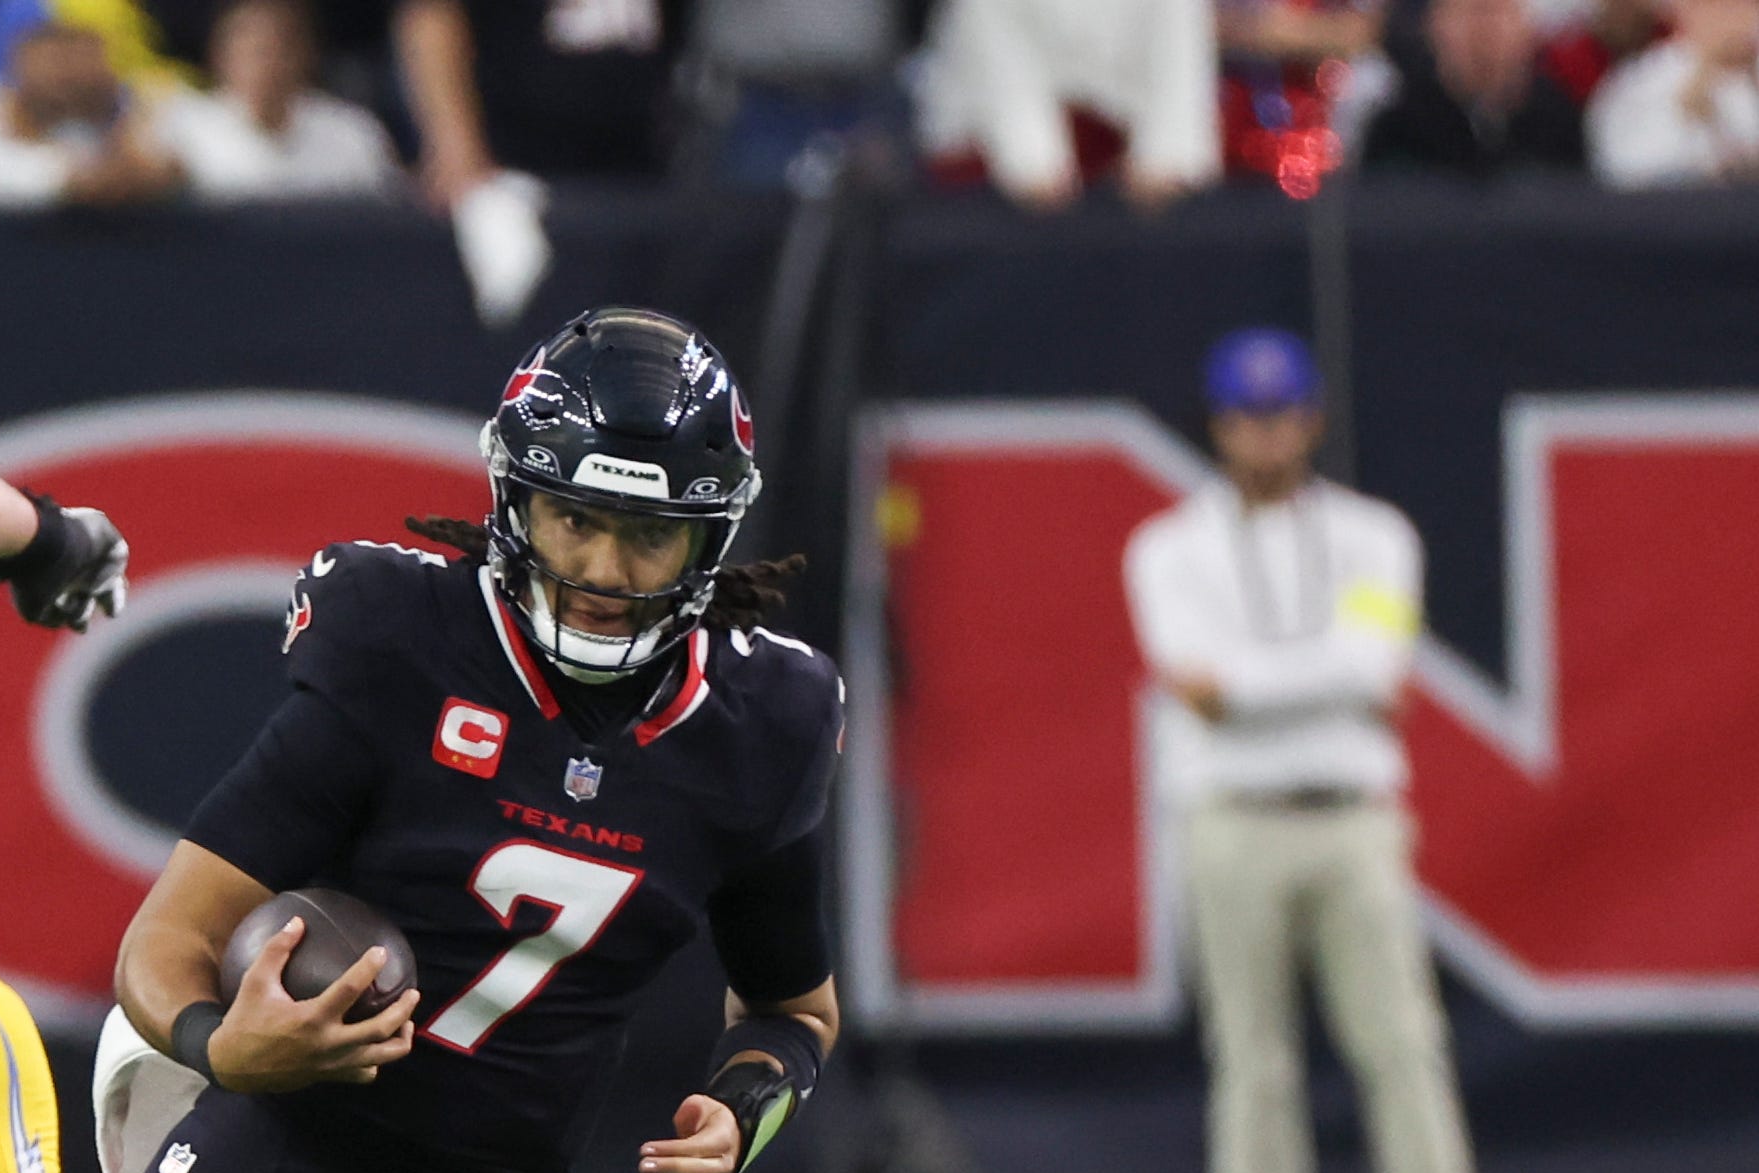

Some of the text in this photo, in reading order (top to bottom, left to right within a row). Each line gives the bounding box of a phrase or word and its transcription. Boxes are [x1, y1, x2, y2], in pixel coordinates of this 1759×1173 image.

[591, 461, 661, 482] TEXANS
[440, 705, 502, 759] C
[496, 799, 645, 853] TEXANS
[419, 837, 646, 1056] 7
